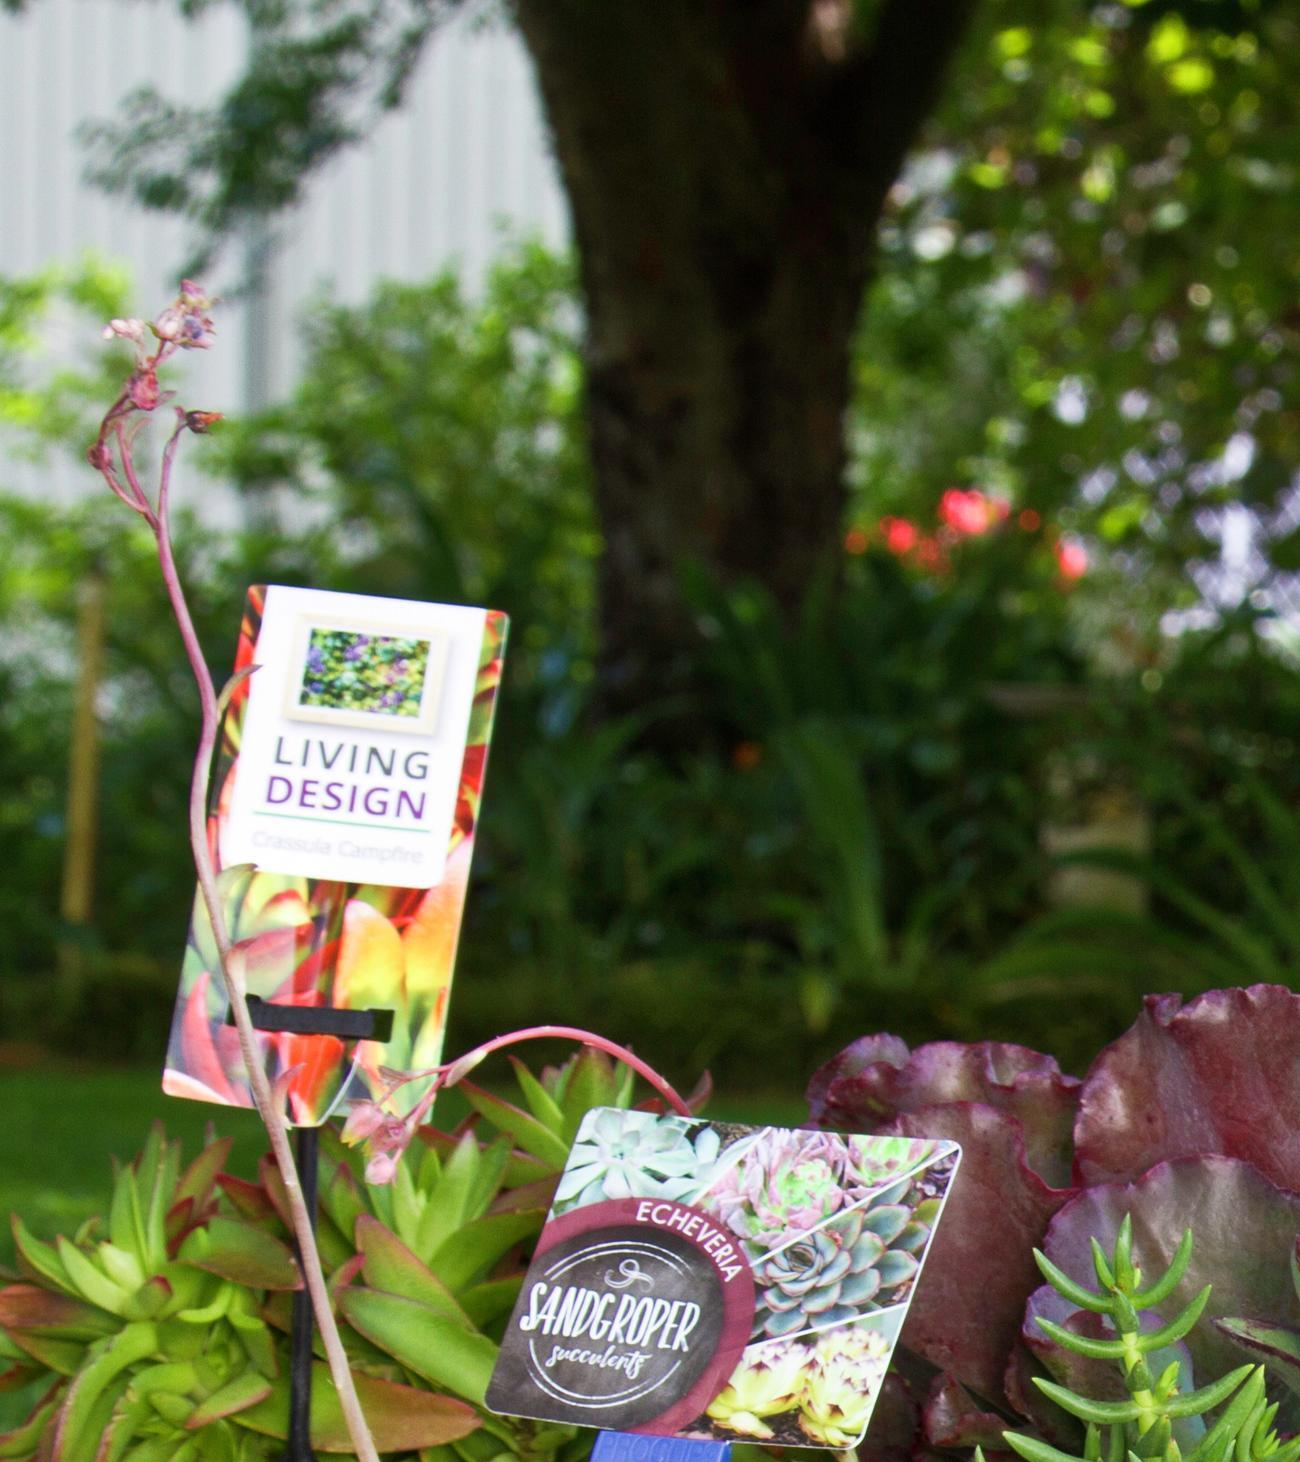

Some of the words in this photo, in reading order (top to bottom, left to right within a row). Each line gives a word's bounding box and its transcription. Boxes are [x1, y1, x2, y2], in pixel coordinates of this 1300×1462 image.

[274, 736, 430, 780] LIVING
[265, 775, 427, 820] DESIGN
[252, 830, 332, 858] Crassula
[337, 840, 426, 865] Campfire
[635, 1201, 744, 1282] ECHEVERIA
[519, 1282, 701, 1352] SANDGROPER
[545, 1345, 653, 1380] succulents
